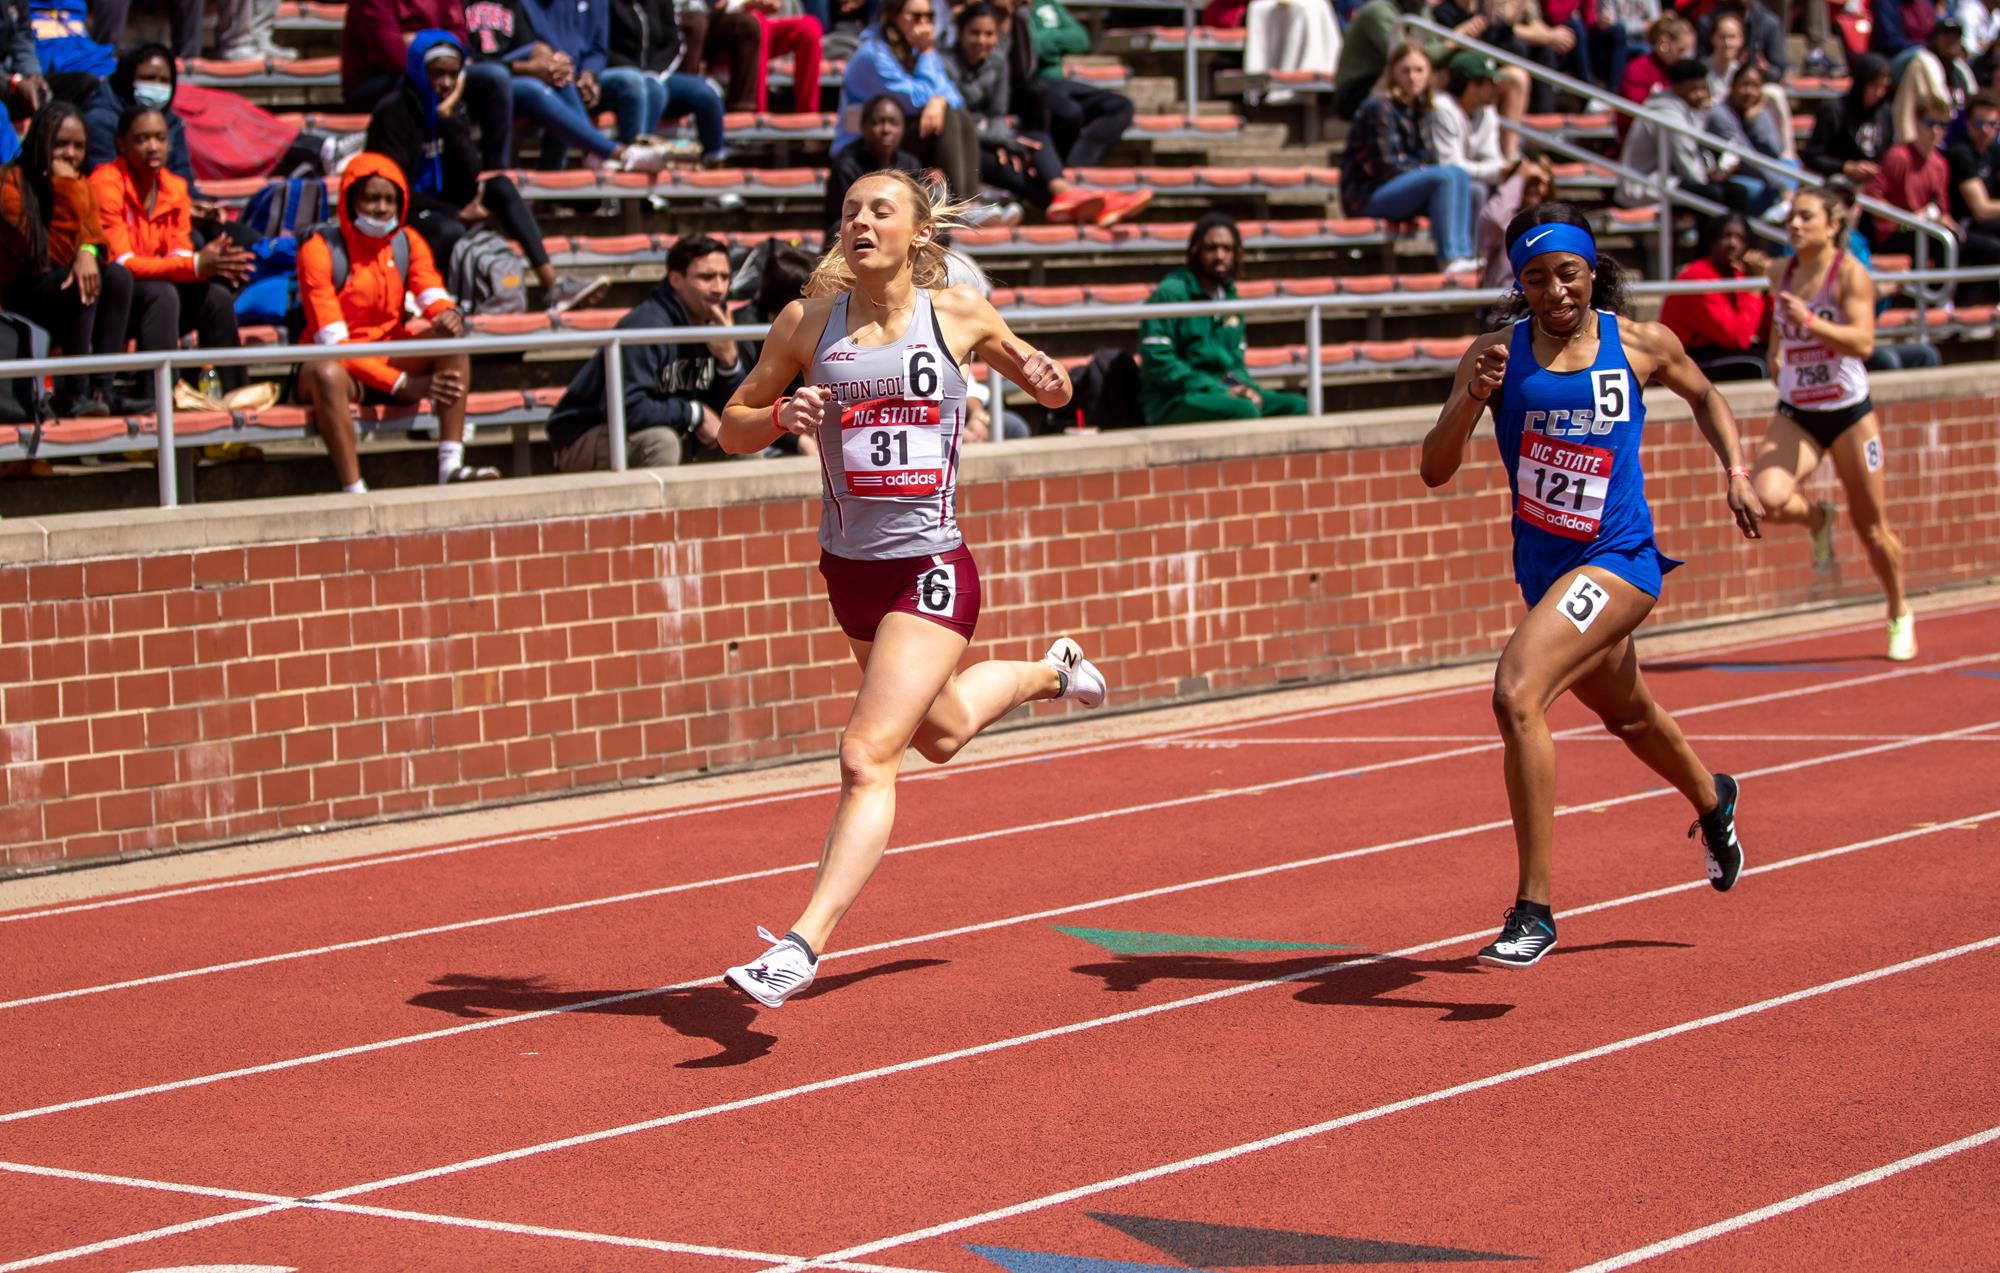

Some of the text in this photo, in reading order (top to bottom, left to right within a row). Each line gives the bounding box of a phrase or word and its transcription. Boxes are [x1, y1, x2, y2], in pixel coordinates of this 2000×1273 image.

[823, 352, 856, 361] ACC
[909, 351, 938, 398] 6
[1796, 364, 1831, 387] 258
[817, 380, 872, 402] OSTON
[1600, 373, 1623, 418] 5
[853, 406, 929, 426] NC STATE
[870, 430, 908, 467] 31
[1530, 442, 1552, 462] NC
[1553, 449, 1603, 474] STATE
[885, 472, 936, 486] adidas
[1533, 467, 1586, 510] 121
[1546, 513, 1593, 533] adidas
[922, 568, 950, 612] 6
[1566, 582, 1602, 622] 5
